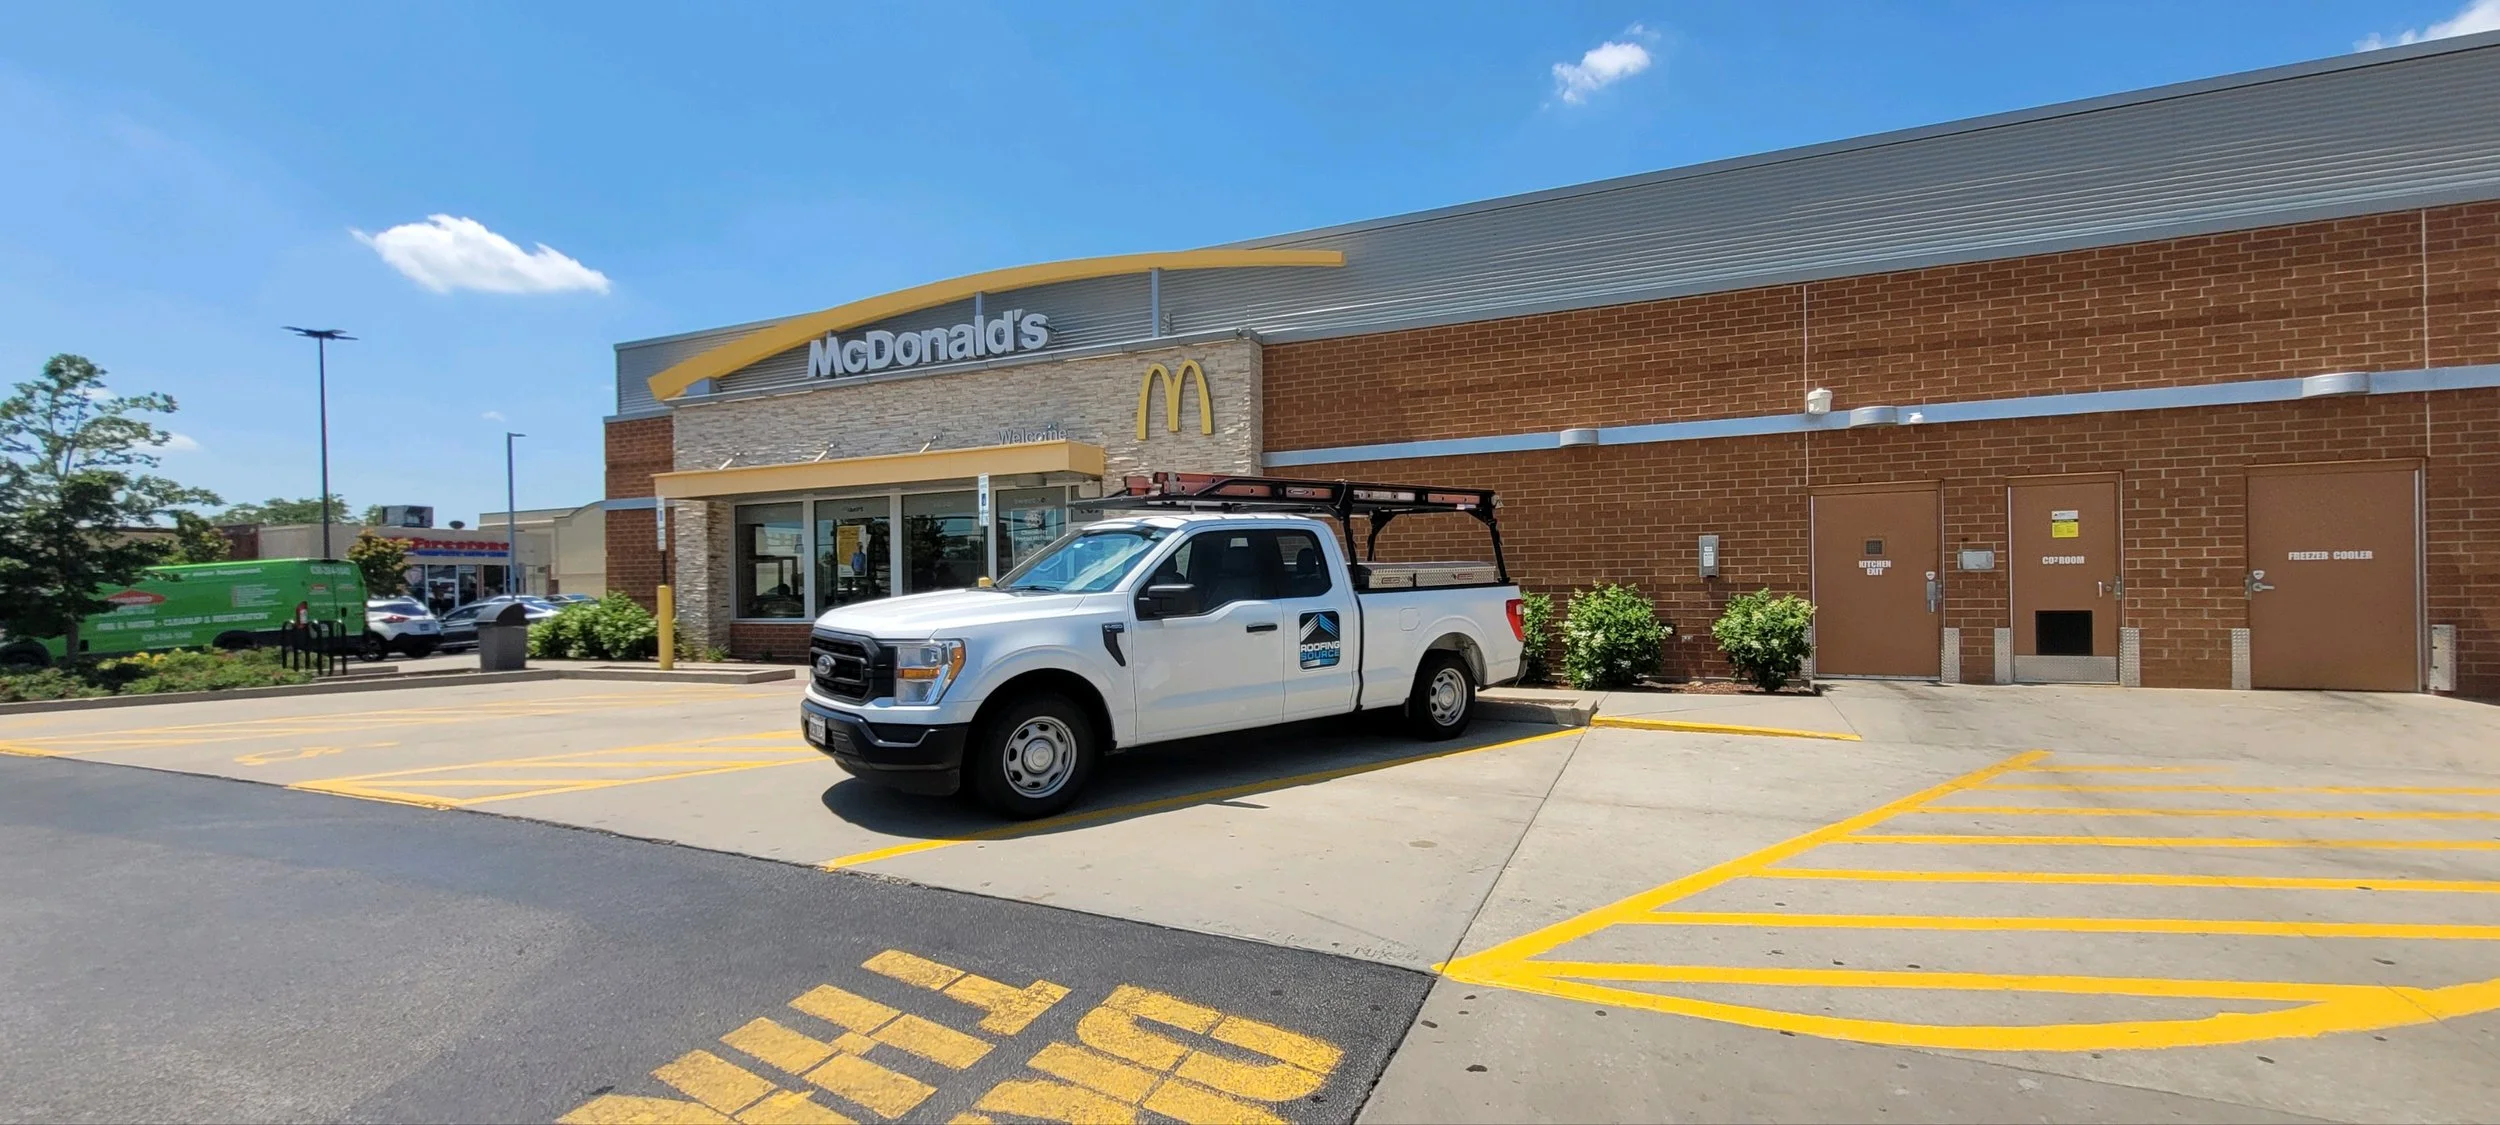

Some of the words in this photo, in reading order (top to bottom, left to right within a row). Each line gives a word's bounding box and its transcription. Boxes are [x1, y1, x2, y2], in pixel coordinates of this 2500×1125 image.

[807, 309, 1050, 378] McDonald's
[998, 427, 1069, 444] Welcome
[2288, 551, 2328, 560] FREEZER
[2333, 551, 2372, 560] COOLER
[1859, 560, 1891, 568] KITCHEN
[1300, 641, 1340, 653] ROOFING
[1300, 649, 1340, 661] SOURCE
